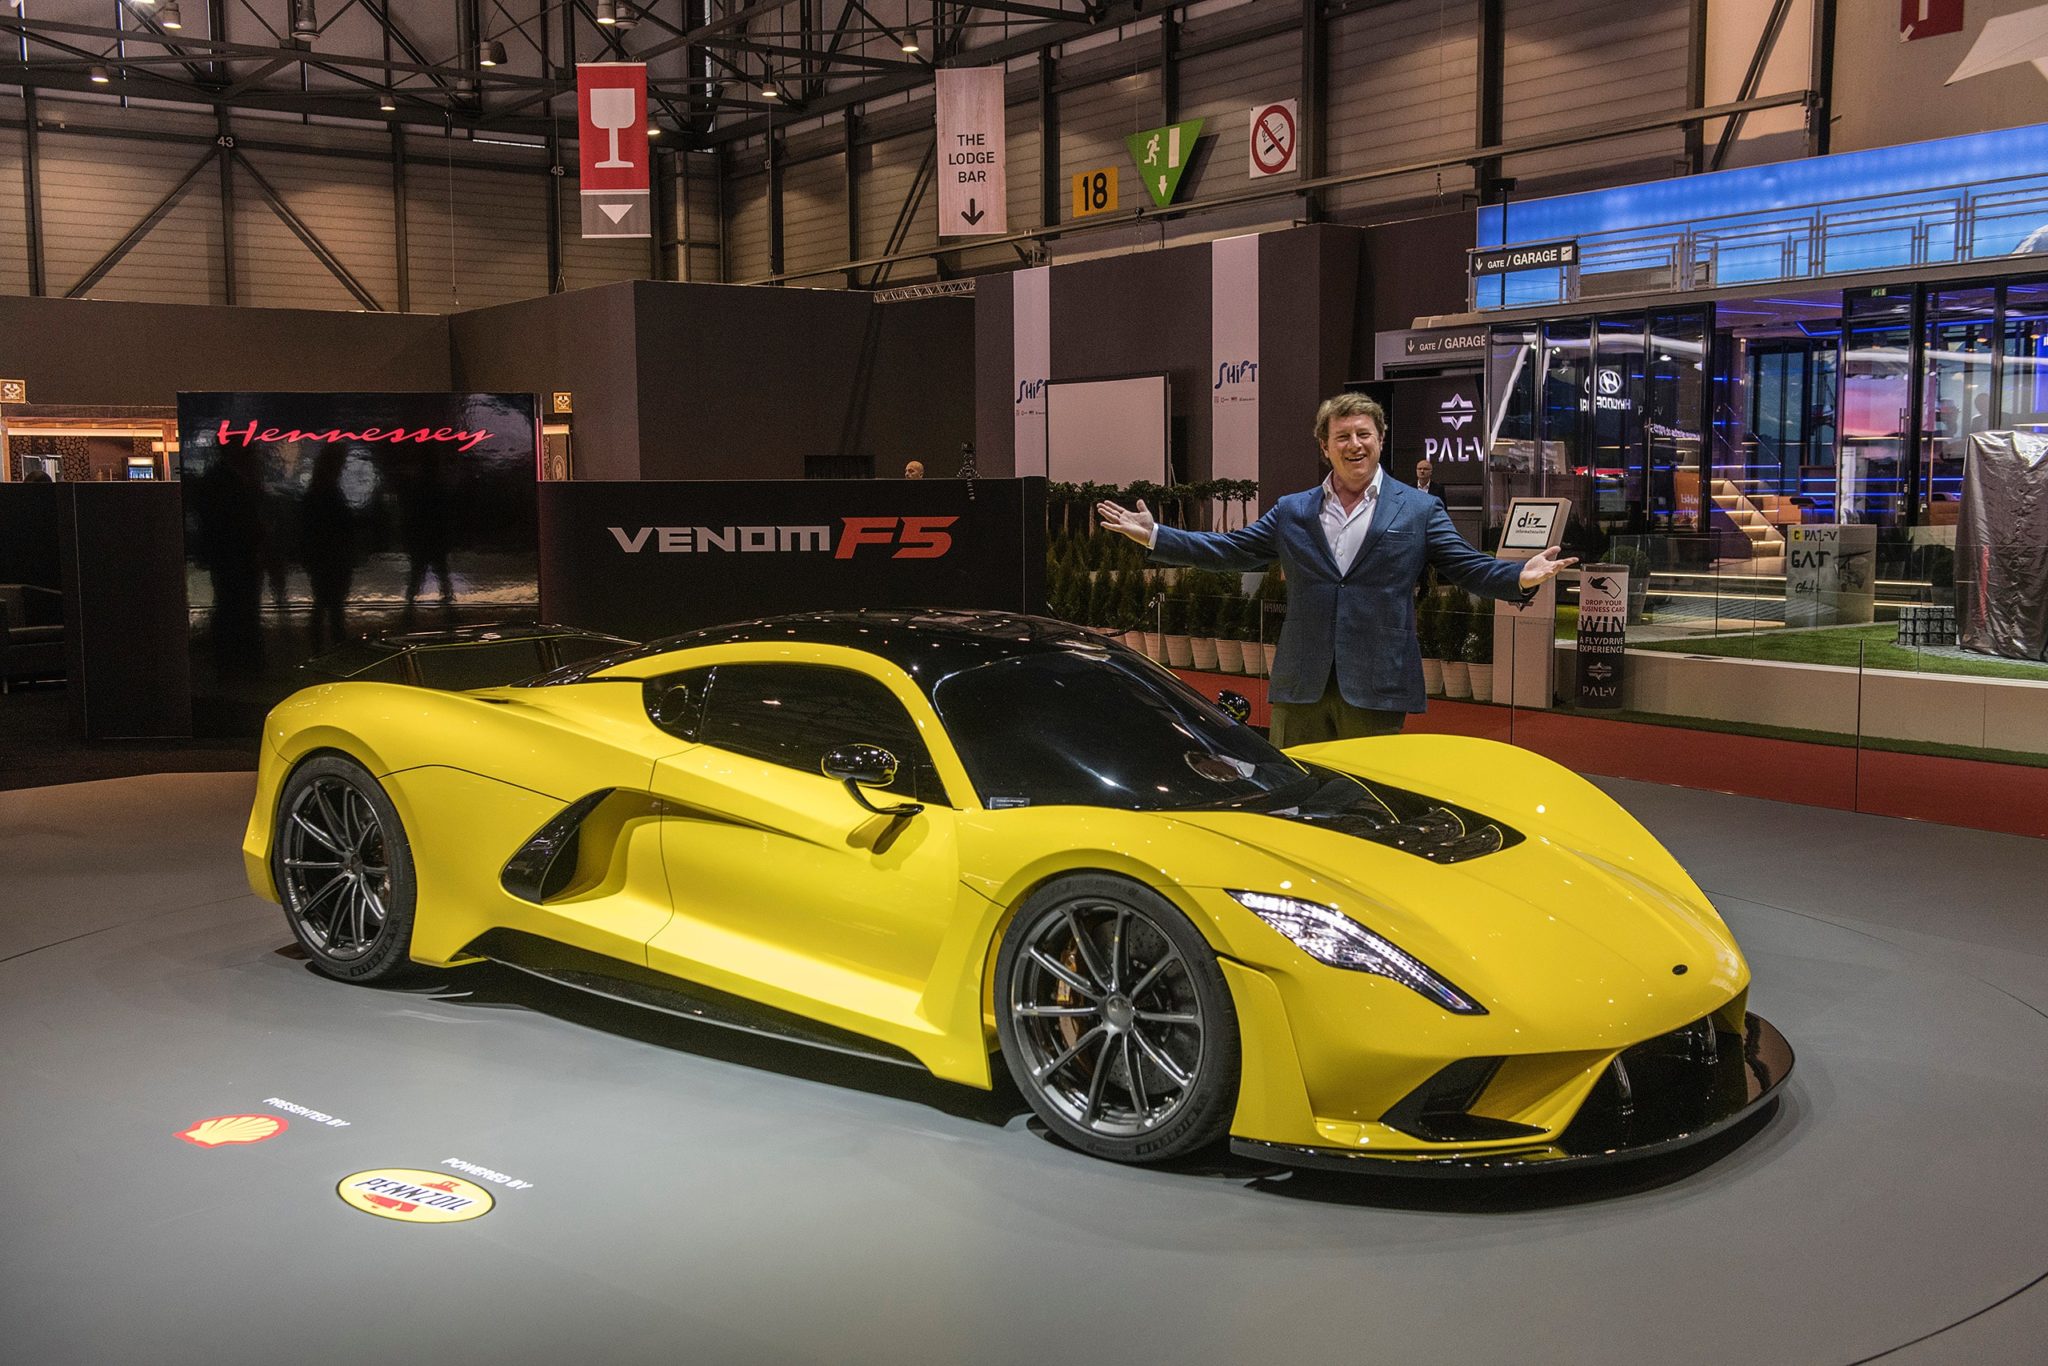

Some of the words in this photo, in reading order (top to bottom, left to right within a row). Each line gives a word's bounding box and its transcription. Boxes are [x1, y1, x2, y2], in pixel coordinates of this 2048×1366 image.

[217, 136, 234, 148] 43
[957, 134, 985, 146] THE
[948, 151, 995, 165] LODGE
[550, 166, 565, 177] 45
[958, 171, 986, 183] BAR
[1083, 172, 1108, 211] 18
[1487, 259, 1505, 269] GATE
[1506, 255, 1512, 267] /
[1513, 249, 1558, 266] GARAGE
[1419, 342, 1436, 351] GATE
[1437, 338, 1443, 350] /
[217, 419, 496, 452] Hennessey
[607, 525, 831, 553] VENOM
[834, 516, 961, 559] F5
[1581, 615, 1625, 632] WIN
[1585, 637, 1624, 645] FLY/DRIVE
[1579, 645, 1623, 653] EXPERIENCE
[1582, 685, 1616, 696] PAL-V
[262, 1097, 333, 1122] PRESENTED
[325, 1118, 351, 1127] BY
[440, 1157, 511, 1184] POWERED
[505, 1178, 534, 1190] BY
[355, 1177, 473, 1211] PENNZOIL
